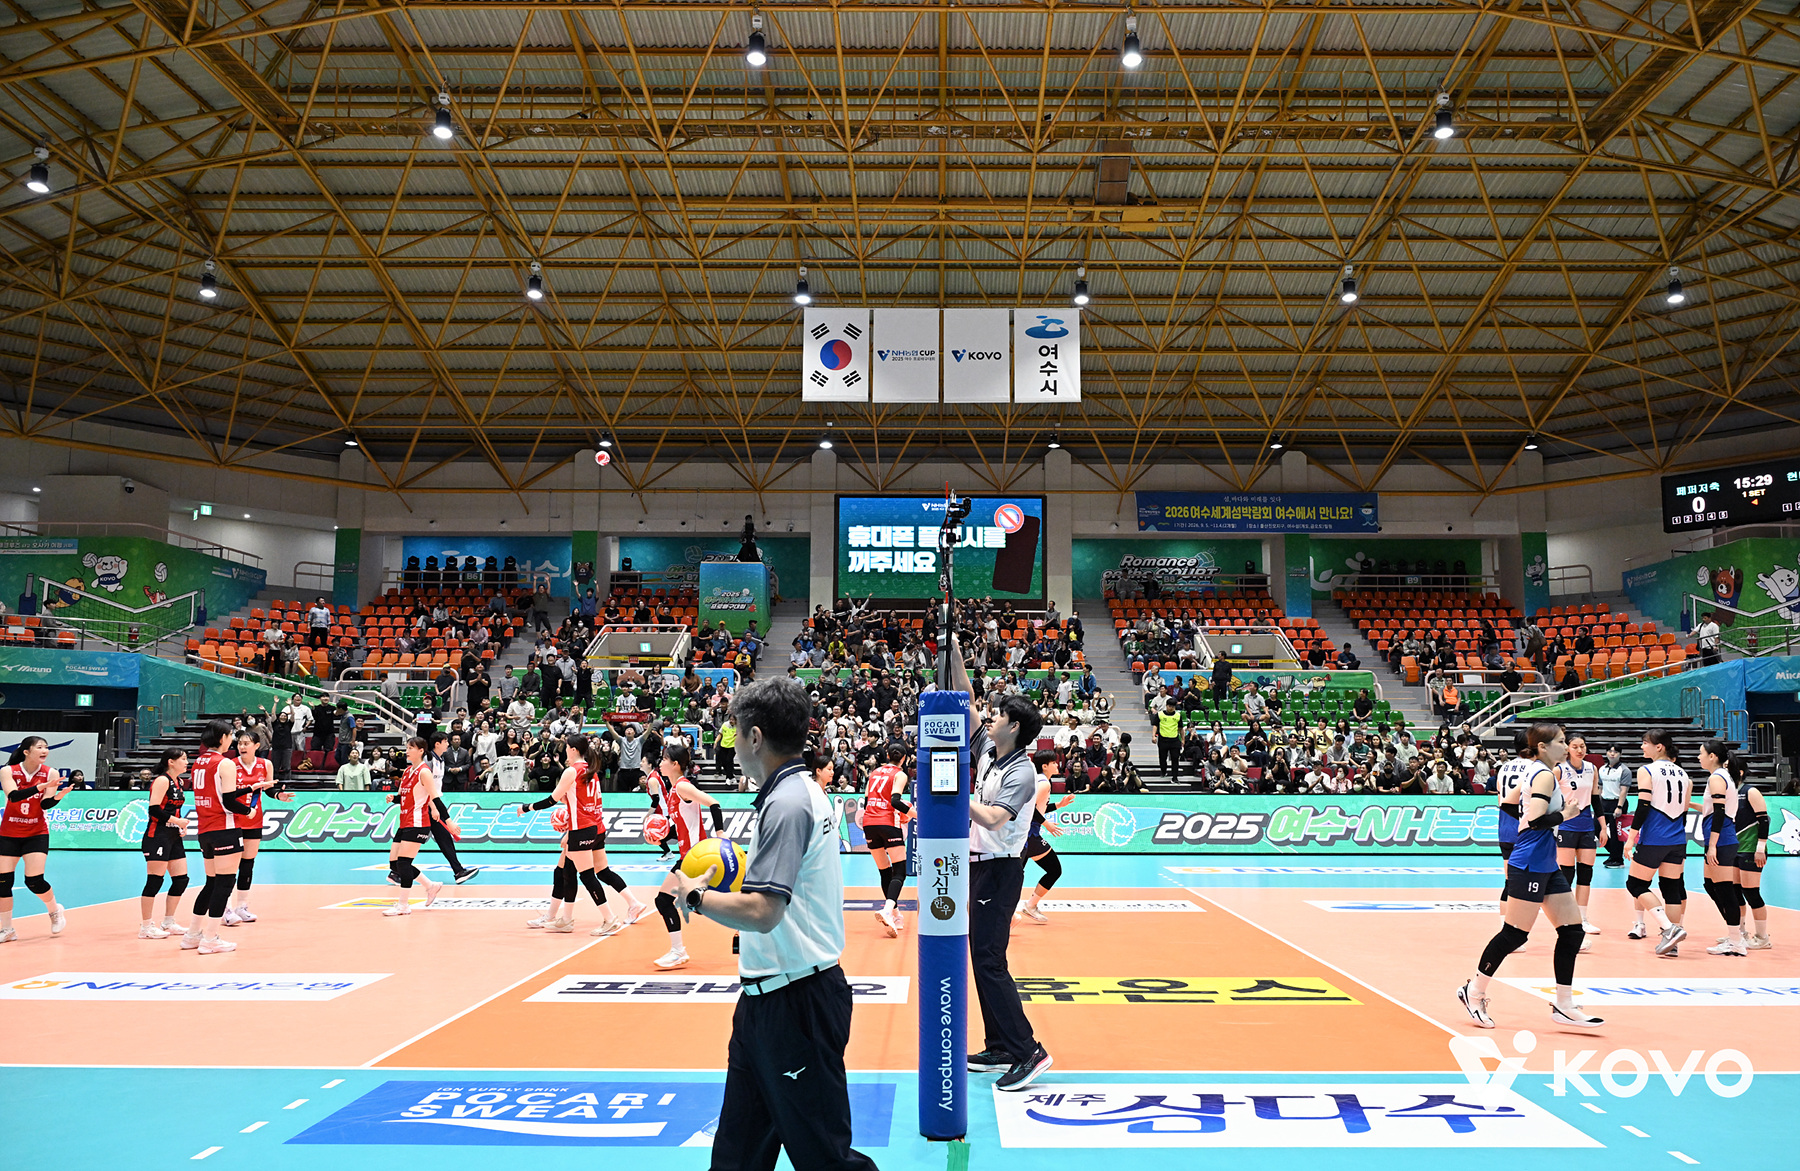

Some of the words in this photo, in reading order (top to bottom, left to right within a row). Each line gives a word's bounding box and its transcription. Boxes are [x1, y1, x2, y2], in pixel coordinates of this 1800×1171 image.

[968, 352, 1002, 360] KOVO
[1038, 343, 1058, 396] 여수시
[1733, 474, 1773, 490] 15:29
[1787, 471, 1800, 481] 현
[1676, 482, 1720, 496] 페퍼저축
[1749, 489, 1766, 497] SET
[1692, 497, 1705, 513] 0
[1275, 506, 1316, 520] 여수에서
[1319, 506, 1353, 520] 만나요!
[848, 525, 915, 548] 휴대폰
[918, 526, 1006, 548] 플시를
[848, 551, 936, 573] 꺼주세요
[1120, 555, 1197, 567] Romance
[194, 769, 206, 789] 10
[870, 776, 889, 793] 77
[1570, 781, 1577, 790] 9
[1666, 779, 1683, 804] 11
[20, 803, 30, 815] 8
[85, 809, 117, 820] CUP
[1060, 812, 1093, 825] CUP
[1155, 814, 1264, 840] 2025
[157, 847, 163, 856] 4
[949, 853, 960, 876] 농협
[1528, 882, 1539, 892] 19
[934, 897, 952, 916] 한우
[940, 976, 952, 1025] wave
[938, 1027, 953, 1112] company
[417, 1093, 677, 1106] POCARI
[1024, 1093, 1107, 1106] 제주
[400, 1105, 644, 1118] SWEAT
[1091, 1093, 1525, 1134] 삼다수
